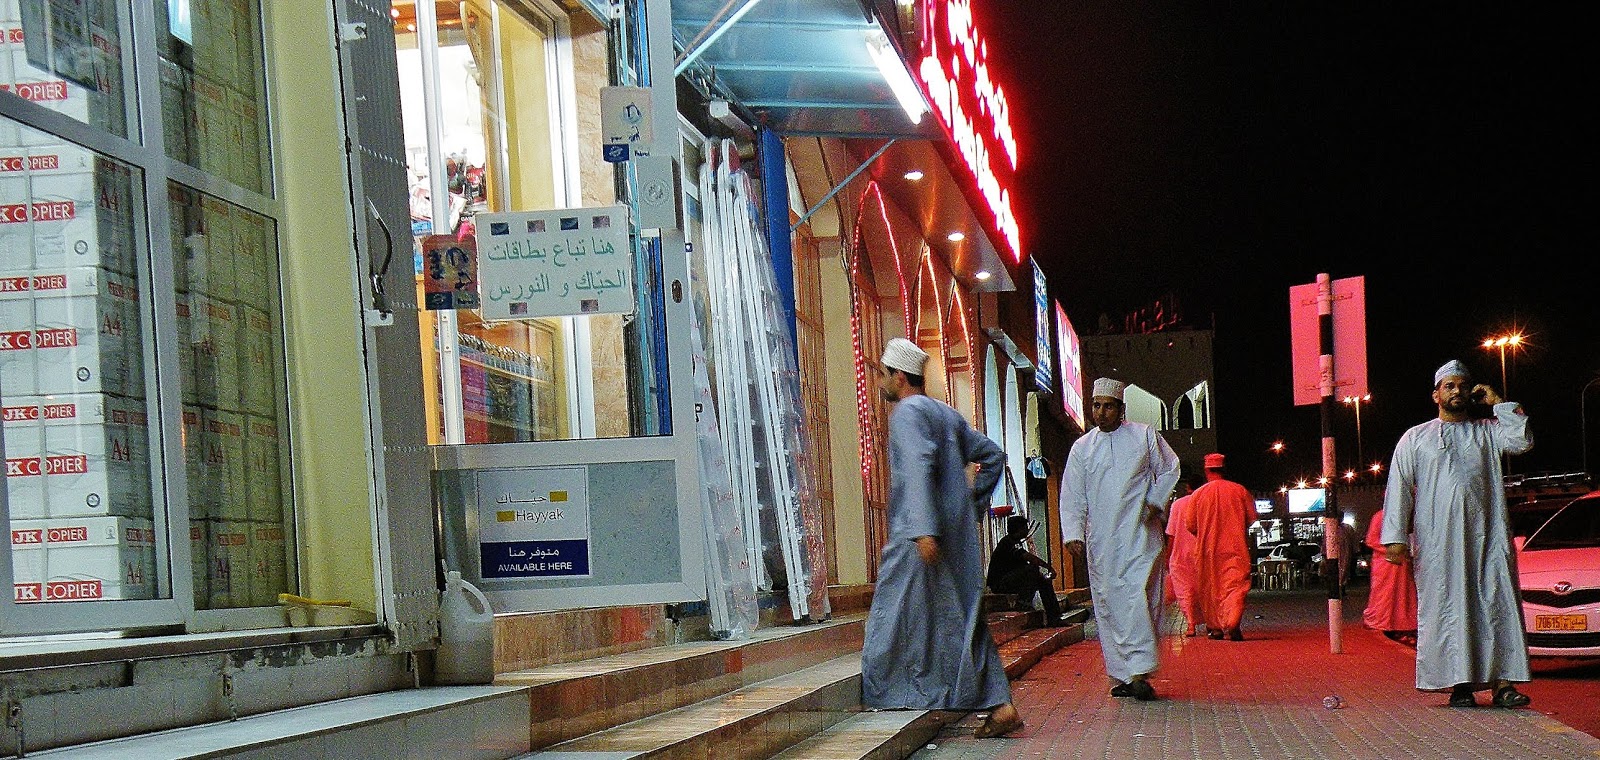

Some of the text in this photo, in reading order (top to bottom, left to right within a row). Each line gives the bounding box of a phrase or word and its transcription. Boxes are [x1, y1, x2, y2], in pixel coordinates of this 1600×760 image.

[17, 84, 64, 101] OPIER
[487, 237, 615, 267] هنا تباع بطاقات
[489, 273, 550, 302] النورس
[559, 282, 570, 298] و
[4, 409, 27, 421] JK
[6, 461, 24, 476] K
[516, 508, 564, 524] Hayyak
[14, 531, 38, 543] JK
[508, 546, 560, 559] متوفر هنا
[498, 561, 572, 572] AVAILABLE HERE
